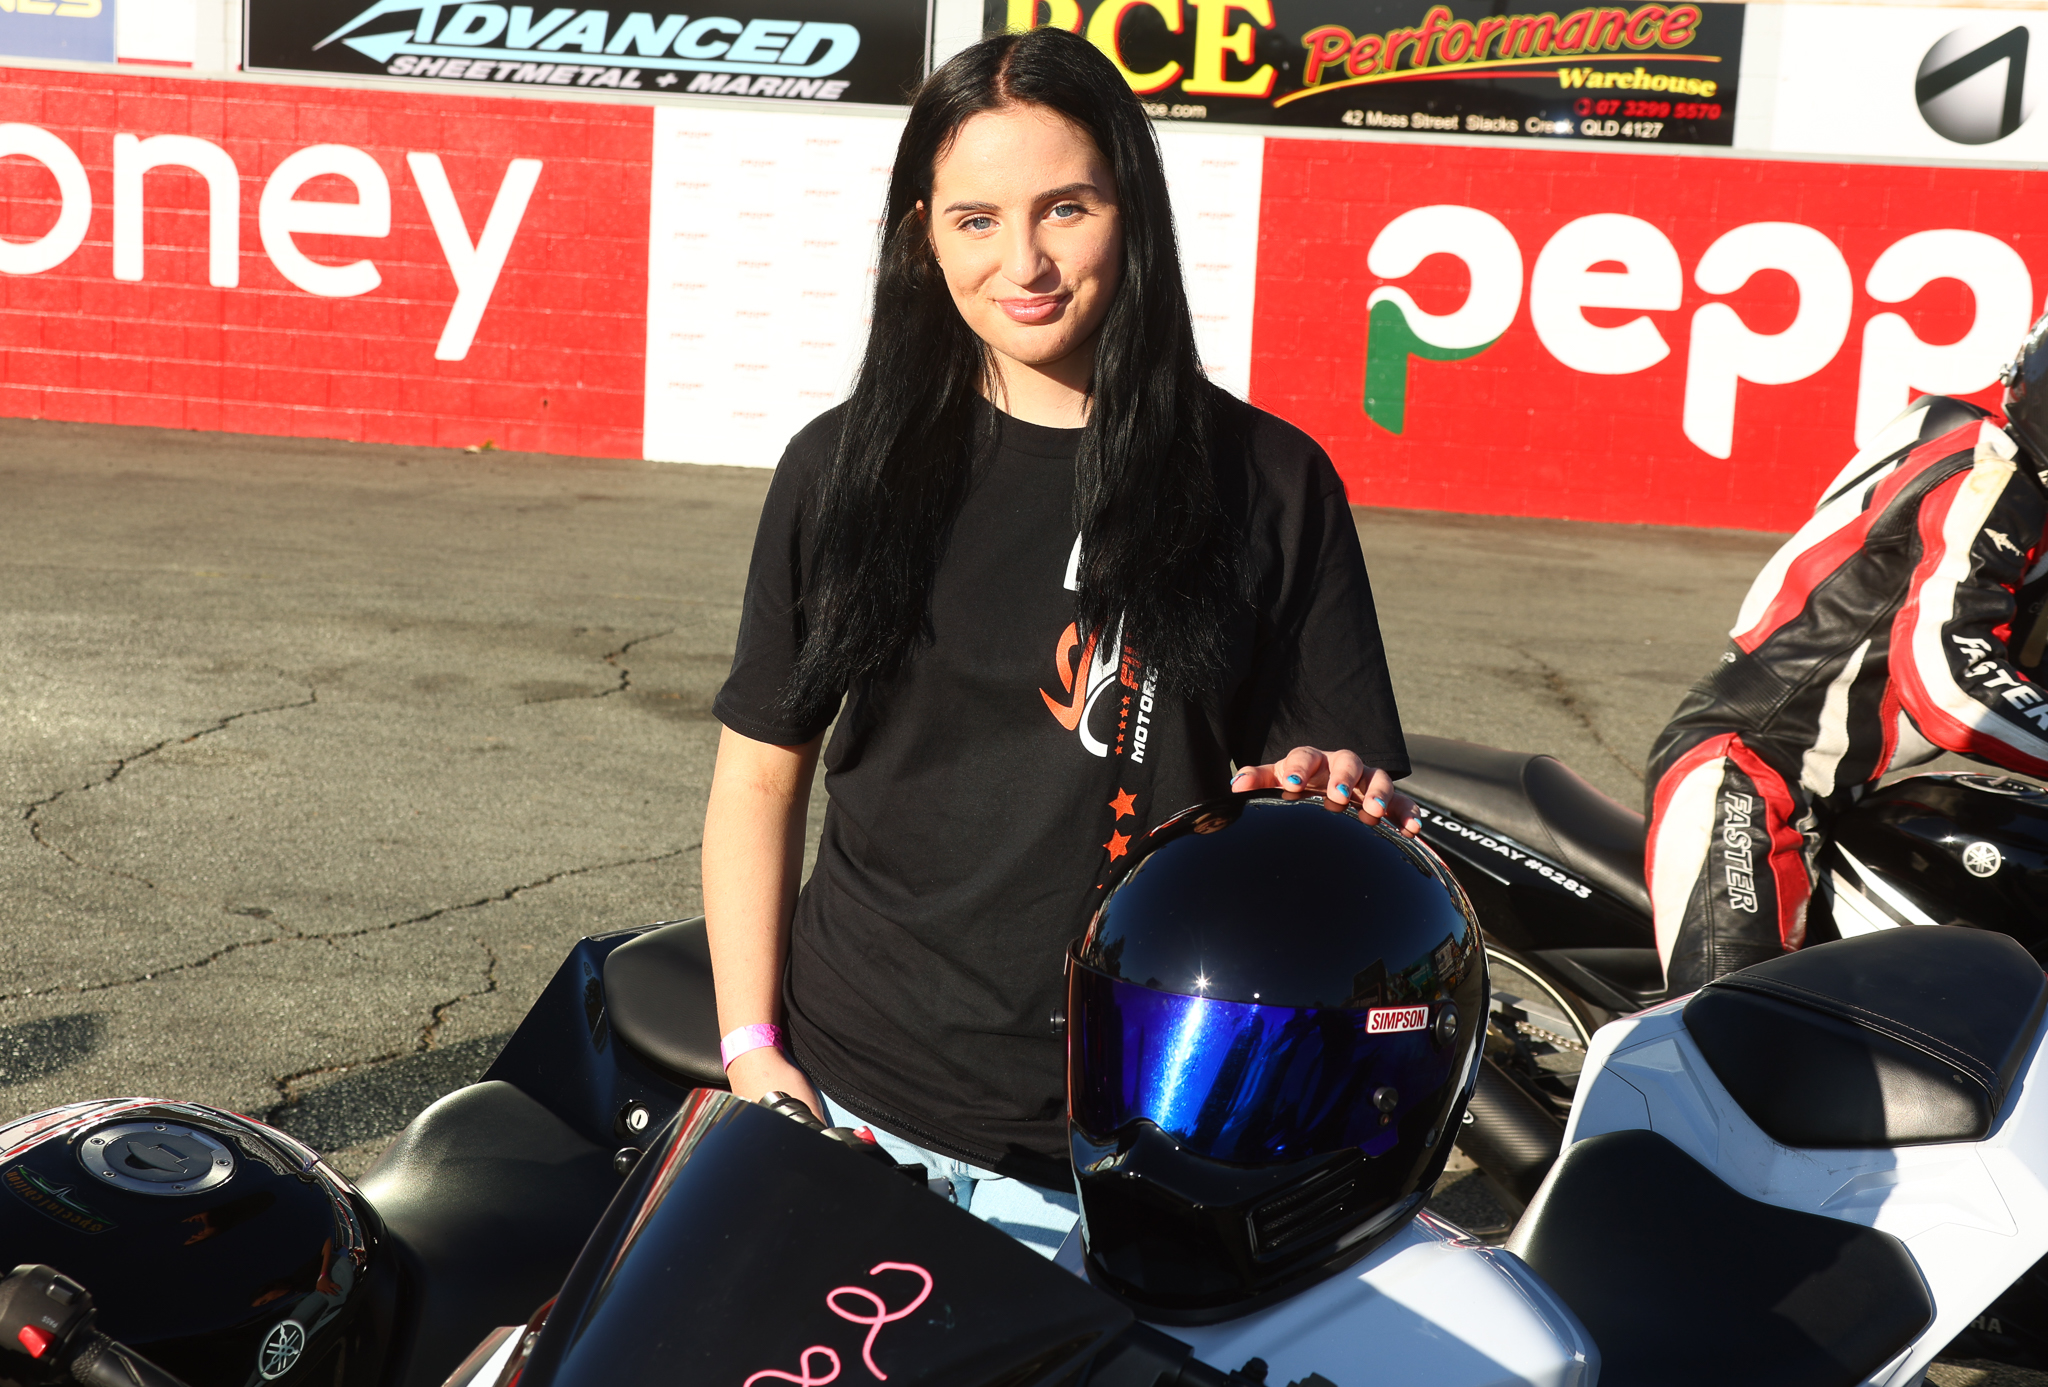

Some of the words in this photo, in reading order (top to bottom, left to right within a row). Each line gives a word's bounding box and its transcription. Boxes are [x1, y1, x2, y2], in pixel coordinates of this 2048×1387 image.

[408, 0, 861, 72] ADVANCED
[1302, 4, 1702, 87] Performance
[387, 55, 641, 89] SHEETMETAL
[687, 74, 850, 100] MARINE
[1557, 67, 1718, 97] Warehouse
[1595, 99, 1621, 117] 07
[1623, 100, 1671, 119] 3299
[1673, 102, 1722, 120] 5570
[1342, 109, 1364, 126] 42
[1365, 111, 1409, 128] Moss
[1411, 113, 1460, 130] Street
[1465, 114, 1519, 133] Slacks
[1580, 119, 1620, 137] QLD
[1620, 120, 1664, 138] 4127
[0, 122, 543, 361] oney
[1363, 204, 2048, 459] pepp
[1431, 815, 1527, 861] LOWDAY
[1524, 858, 1593, 899] #6283
[1724, 791, 1758, 913] FASTER
[1371, 1009, 1426, 1031] SIMPSON
